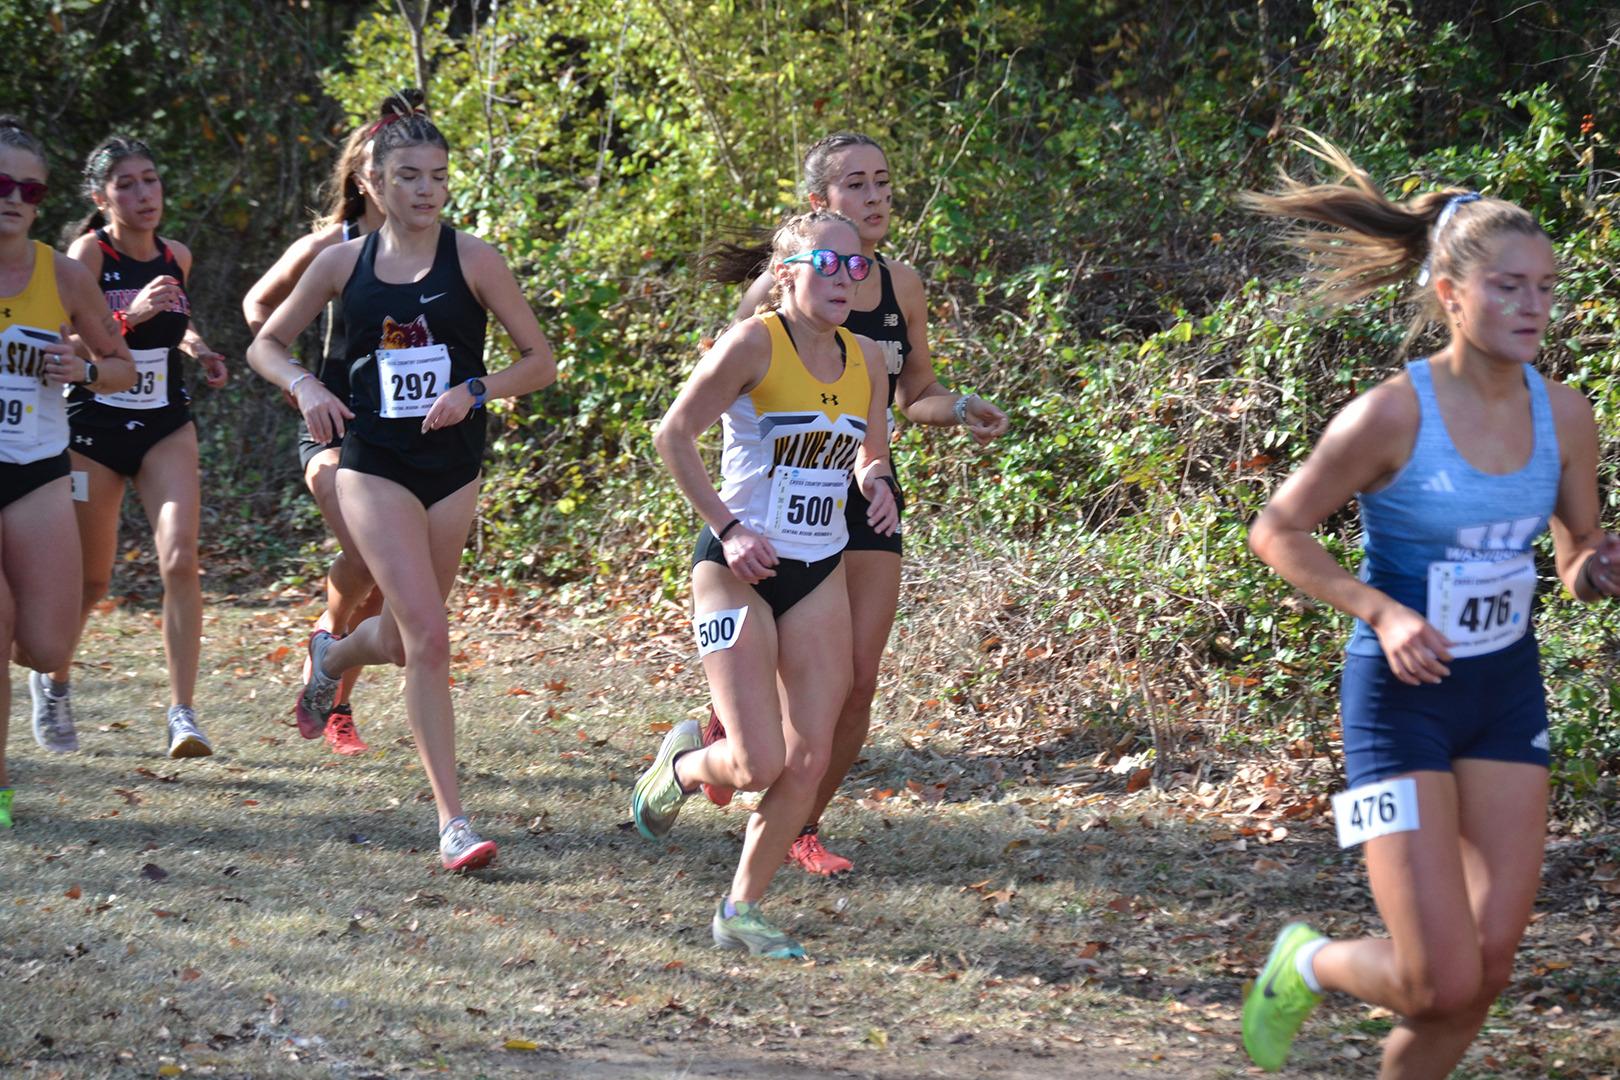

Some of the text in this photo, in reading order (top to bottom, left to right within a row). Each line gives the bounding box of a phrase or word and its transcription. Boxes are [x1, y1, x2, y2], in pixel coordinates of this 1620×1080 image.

[391, 371, 438, 402] 292
[787, 494, 834, 527] 500
[1459, 589, 1513, 633] 476
[699, 617, 735, 648] 500
[1351, 792, 1397, 831] 476
